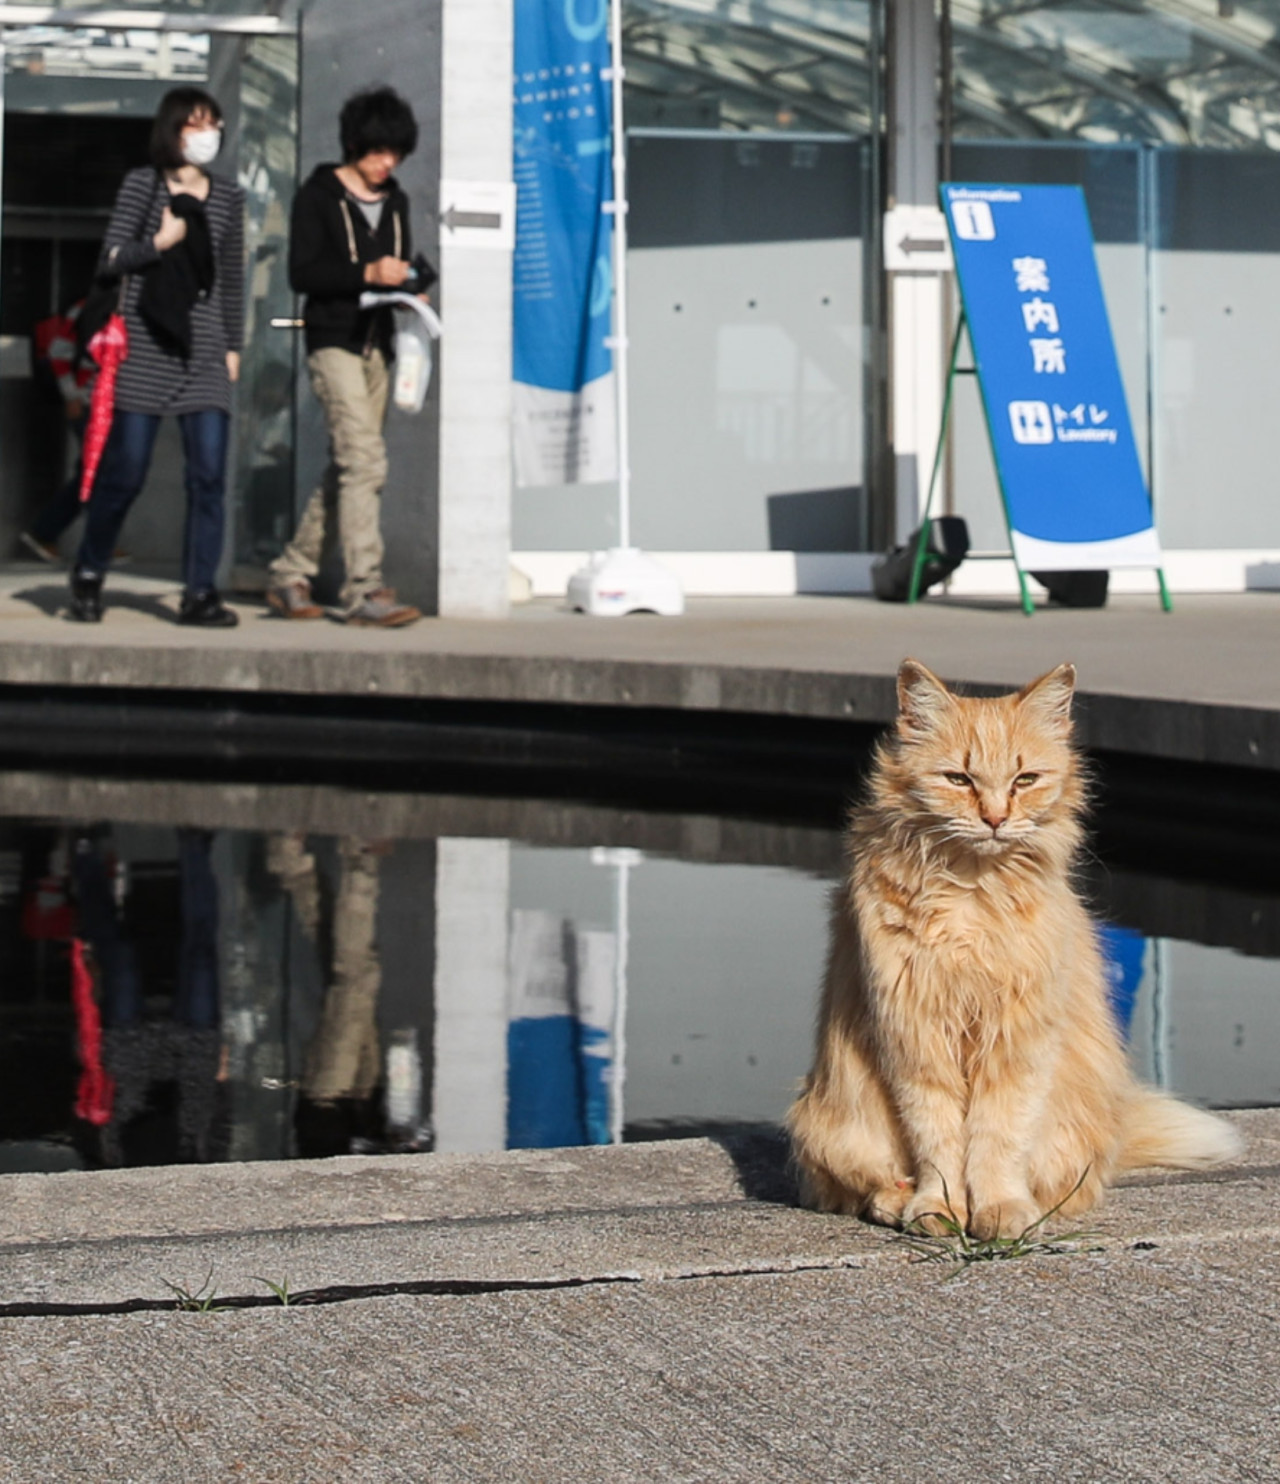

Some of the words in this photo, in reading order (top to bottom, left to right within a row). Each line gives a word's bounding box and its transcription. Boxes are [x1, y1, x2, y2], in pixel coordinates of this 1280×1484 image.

[1012, 256, 1066, 374] 案内所
[1052, 403, 1109, 426] トイレ
